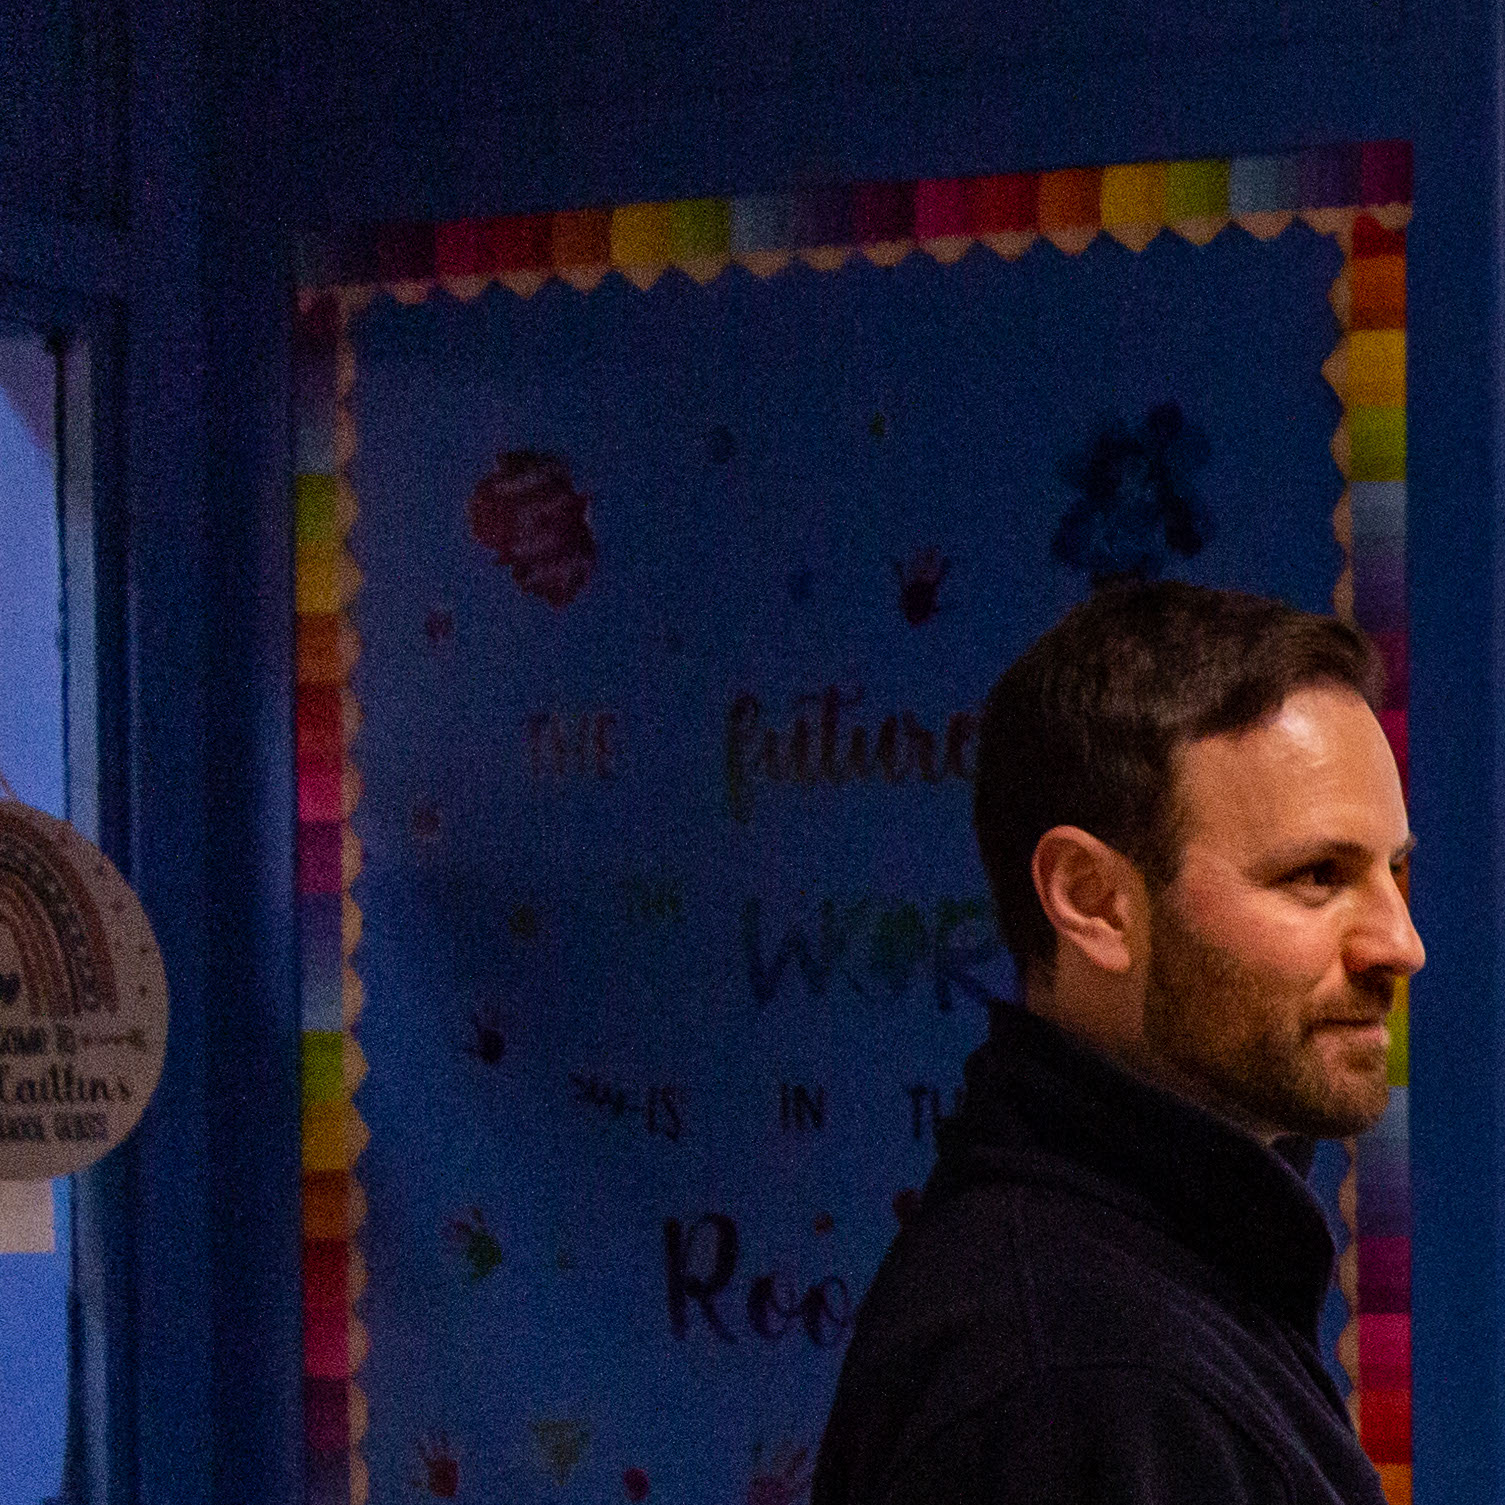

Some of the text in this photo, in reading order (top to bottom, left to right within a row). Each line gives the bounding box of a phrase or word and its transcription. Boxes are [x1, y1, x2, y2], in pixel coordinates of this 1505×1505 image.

[527, 712, 616, 780] THE
[742, 895, 995, 1014] WOR
[779, 1081, 826, 1132] IN
[663, 1213, 855, 1350] Roo
